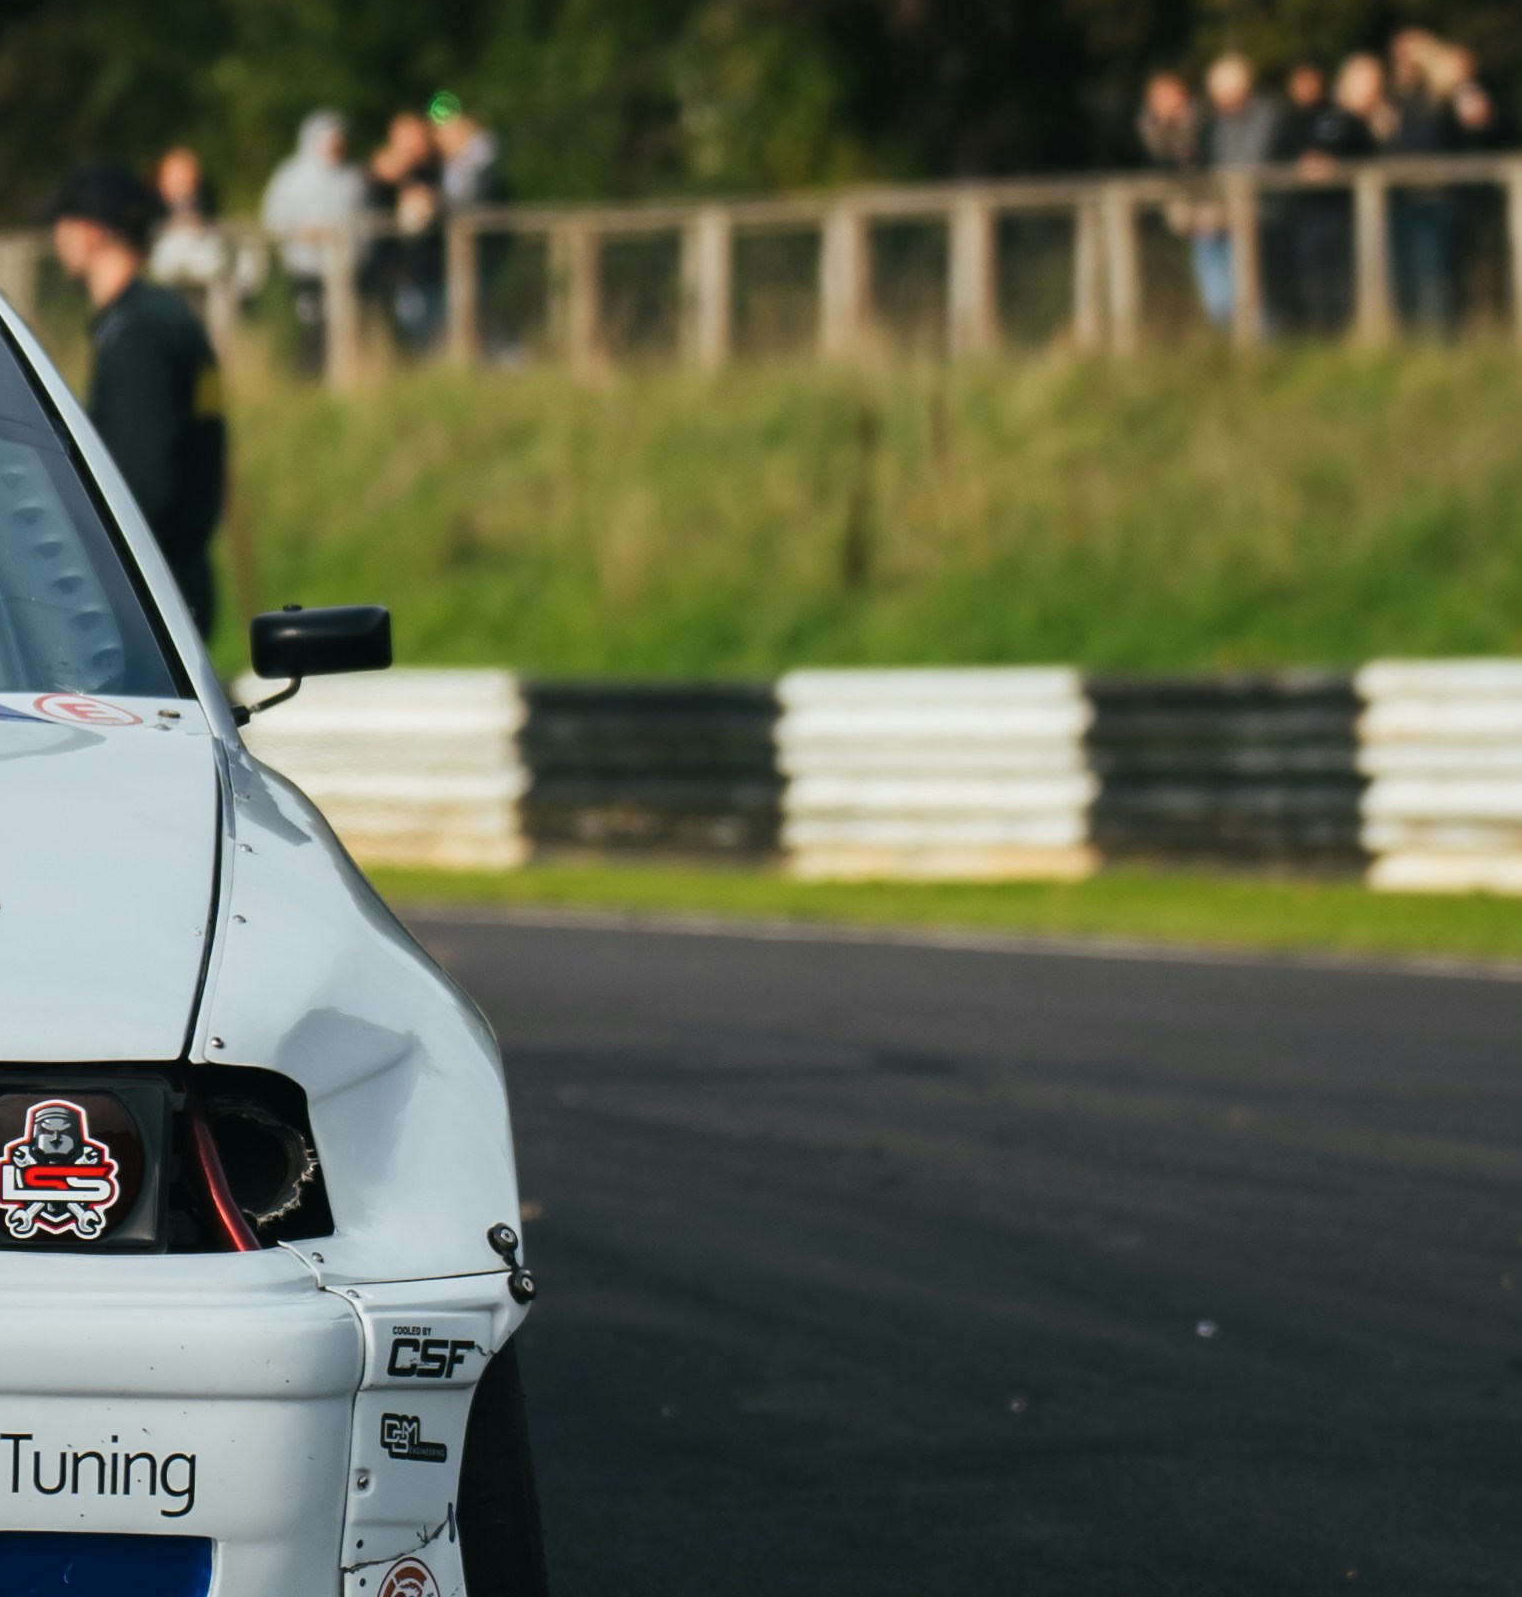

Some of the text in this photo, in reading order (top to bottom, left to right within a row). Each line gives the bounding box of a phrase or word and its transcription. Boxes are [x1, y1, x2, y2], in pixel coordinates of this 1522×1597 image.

[392, 1326, 431, 1335] COOLED BY
[387, 1338, 475, 1378] CSF
[0, 1433, 196, 1518] Tuning
